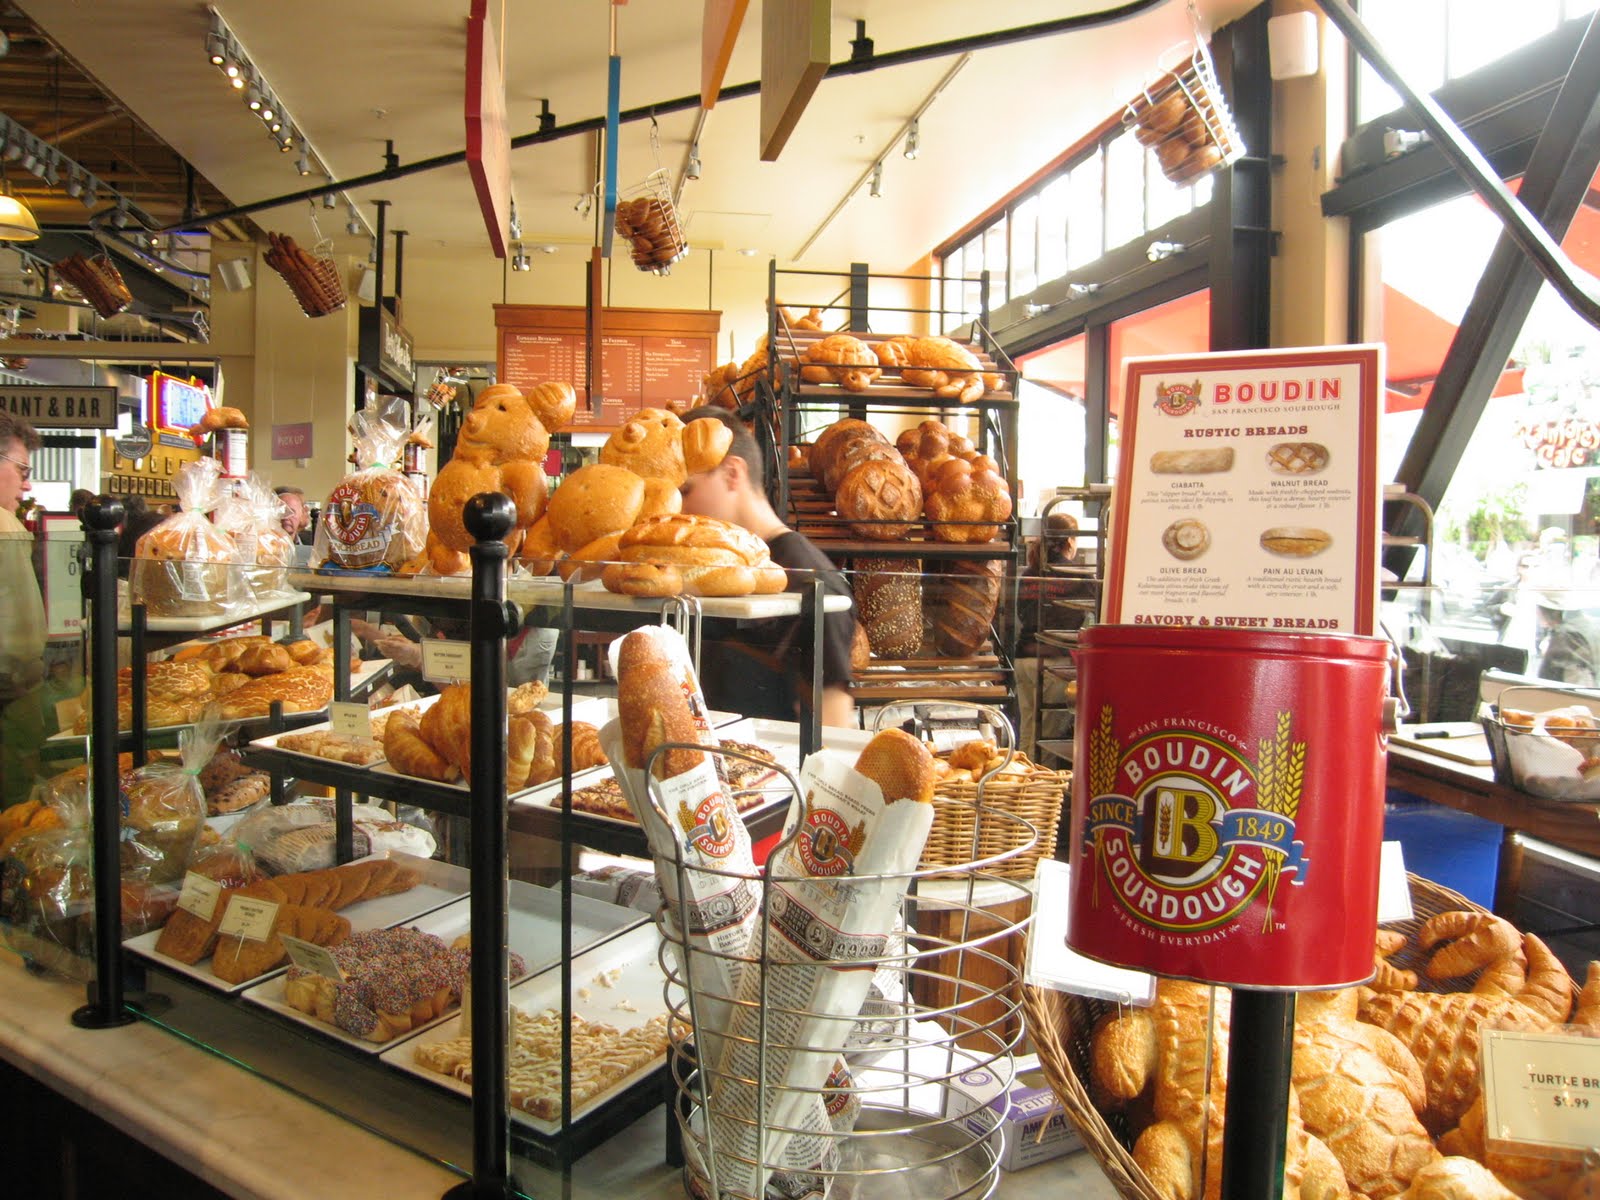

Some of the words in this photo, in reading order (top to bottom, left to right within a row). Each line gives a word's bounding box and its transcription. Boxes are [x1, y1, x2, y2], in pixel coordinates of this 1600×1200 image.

[1214, 378, 1342, 404] BOUDIN
[48, 397, 59, 417] &
[66, 397, 100, 418] BAR
[294, 434, 304, 445] UP
[1184, 428, 1240, 438] RUSTIC
[1245, 426, 1308, 436] BREADS
[1134, 615, 1194, 625] SAVORY
[1199, 616, 1210, 626] &
[1214, 616, 1268, 627] SWEET
[1272, 618, 1339, 629] BREADS
[1138, 720, 1158, 734] SAN
[1164, 718, 1237, 743] FRANCISCO
[1124, 742, 1250, 797] BOUDIN
[1091, 802, 1135, 825] SINCE
[813, 813, 848, 844] BOUDIN
[1236, 817, 1286, 843] 1849
[800, 837, 842, 876] SOURDOUGH
[1106, 838, 1262, 920] SOURDOUGH
[1120, 914, 1155, 940] FRESH
[1159, 930, 1228, 946] EVERYDAY
[1529, 1073, 1578, 1087] TURTLE
[1554, 1095, 1589, 1108] $.99
